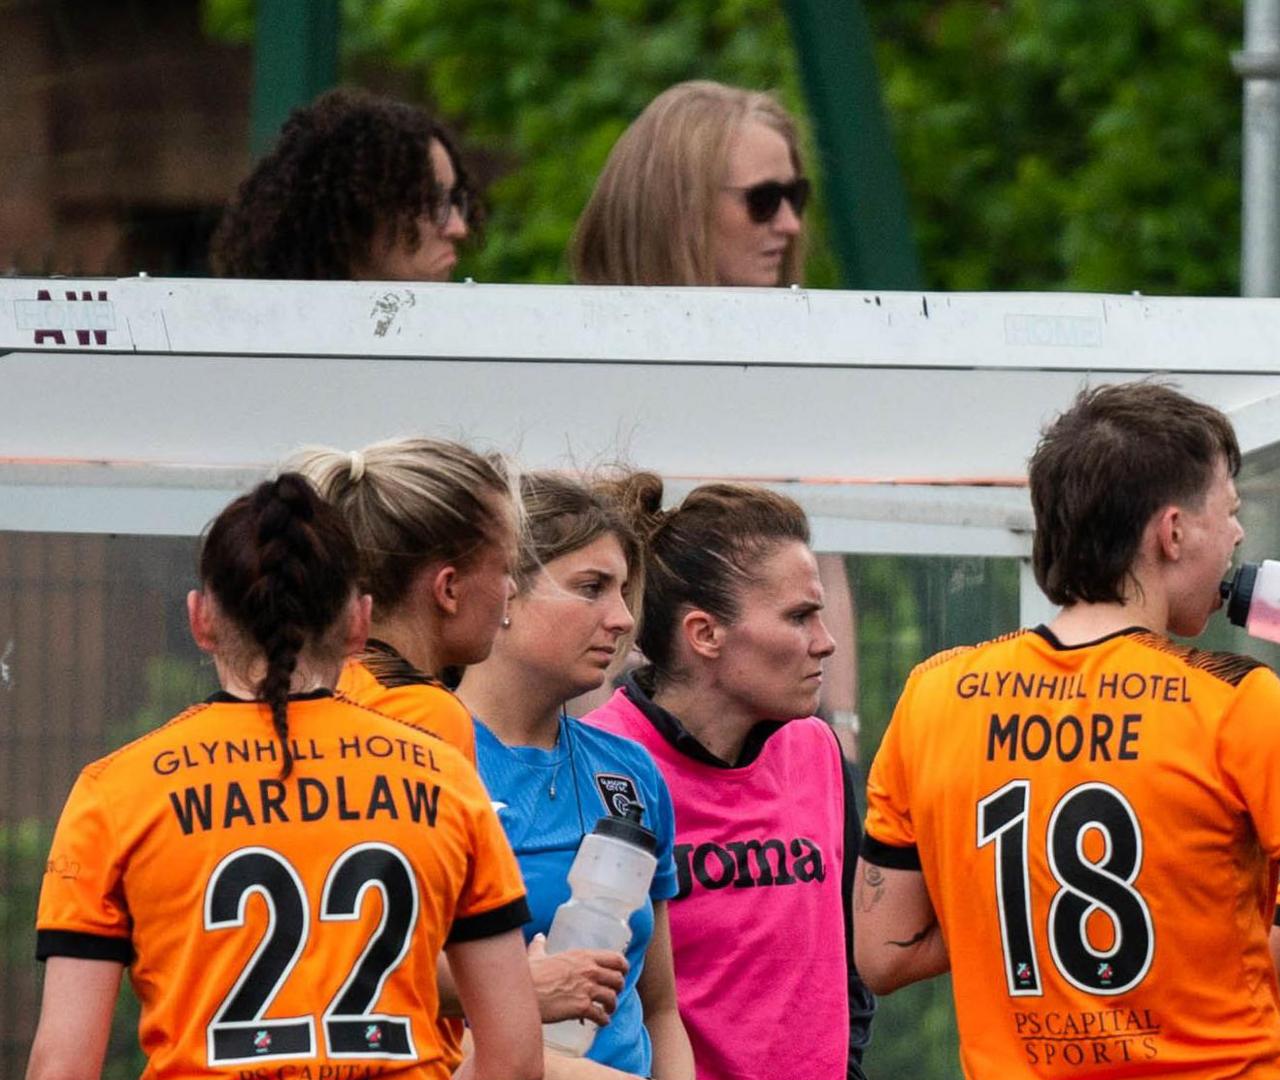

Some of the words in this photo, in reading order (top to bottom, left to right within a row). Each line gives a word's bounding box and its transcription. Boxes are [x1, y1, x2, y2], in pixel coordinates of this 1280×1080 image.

[956, 672, 1087, 700] GLYNHILL
[1098, 673, 1192, 703] HOTEL
[153, 739, 324, 775] GLYNHLL
[340, 735, 441, 773] HOTEL
[986, 713, 1143, 763] MOORE
[169, 774, 441, 836] WARDLAW
[976, 778, 1155, 997] 18
[204, 841, 419, 1069] 22
[1014, 1012, 1040, 1034] PS
[1045, 1008, 1162, 1035] CAPITAL
[1025, 1038, 1158, 1066] SPORTS
